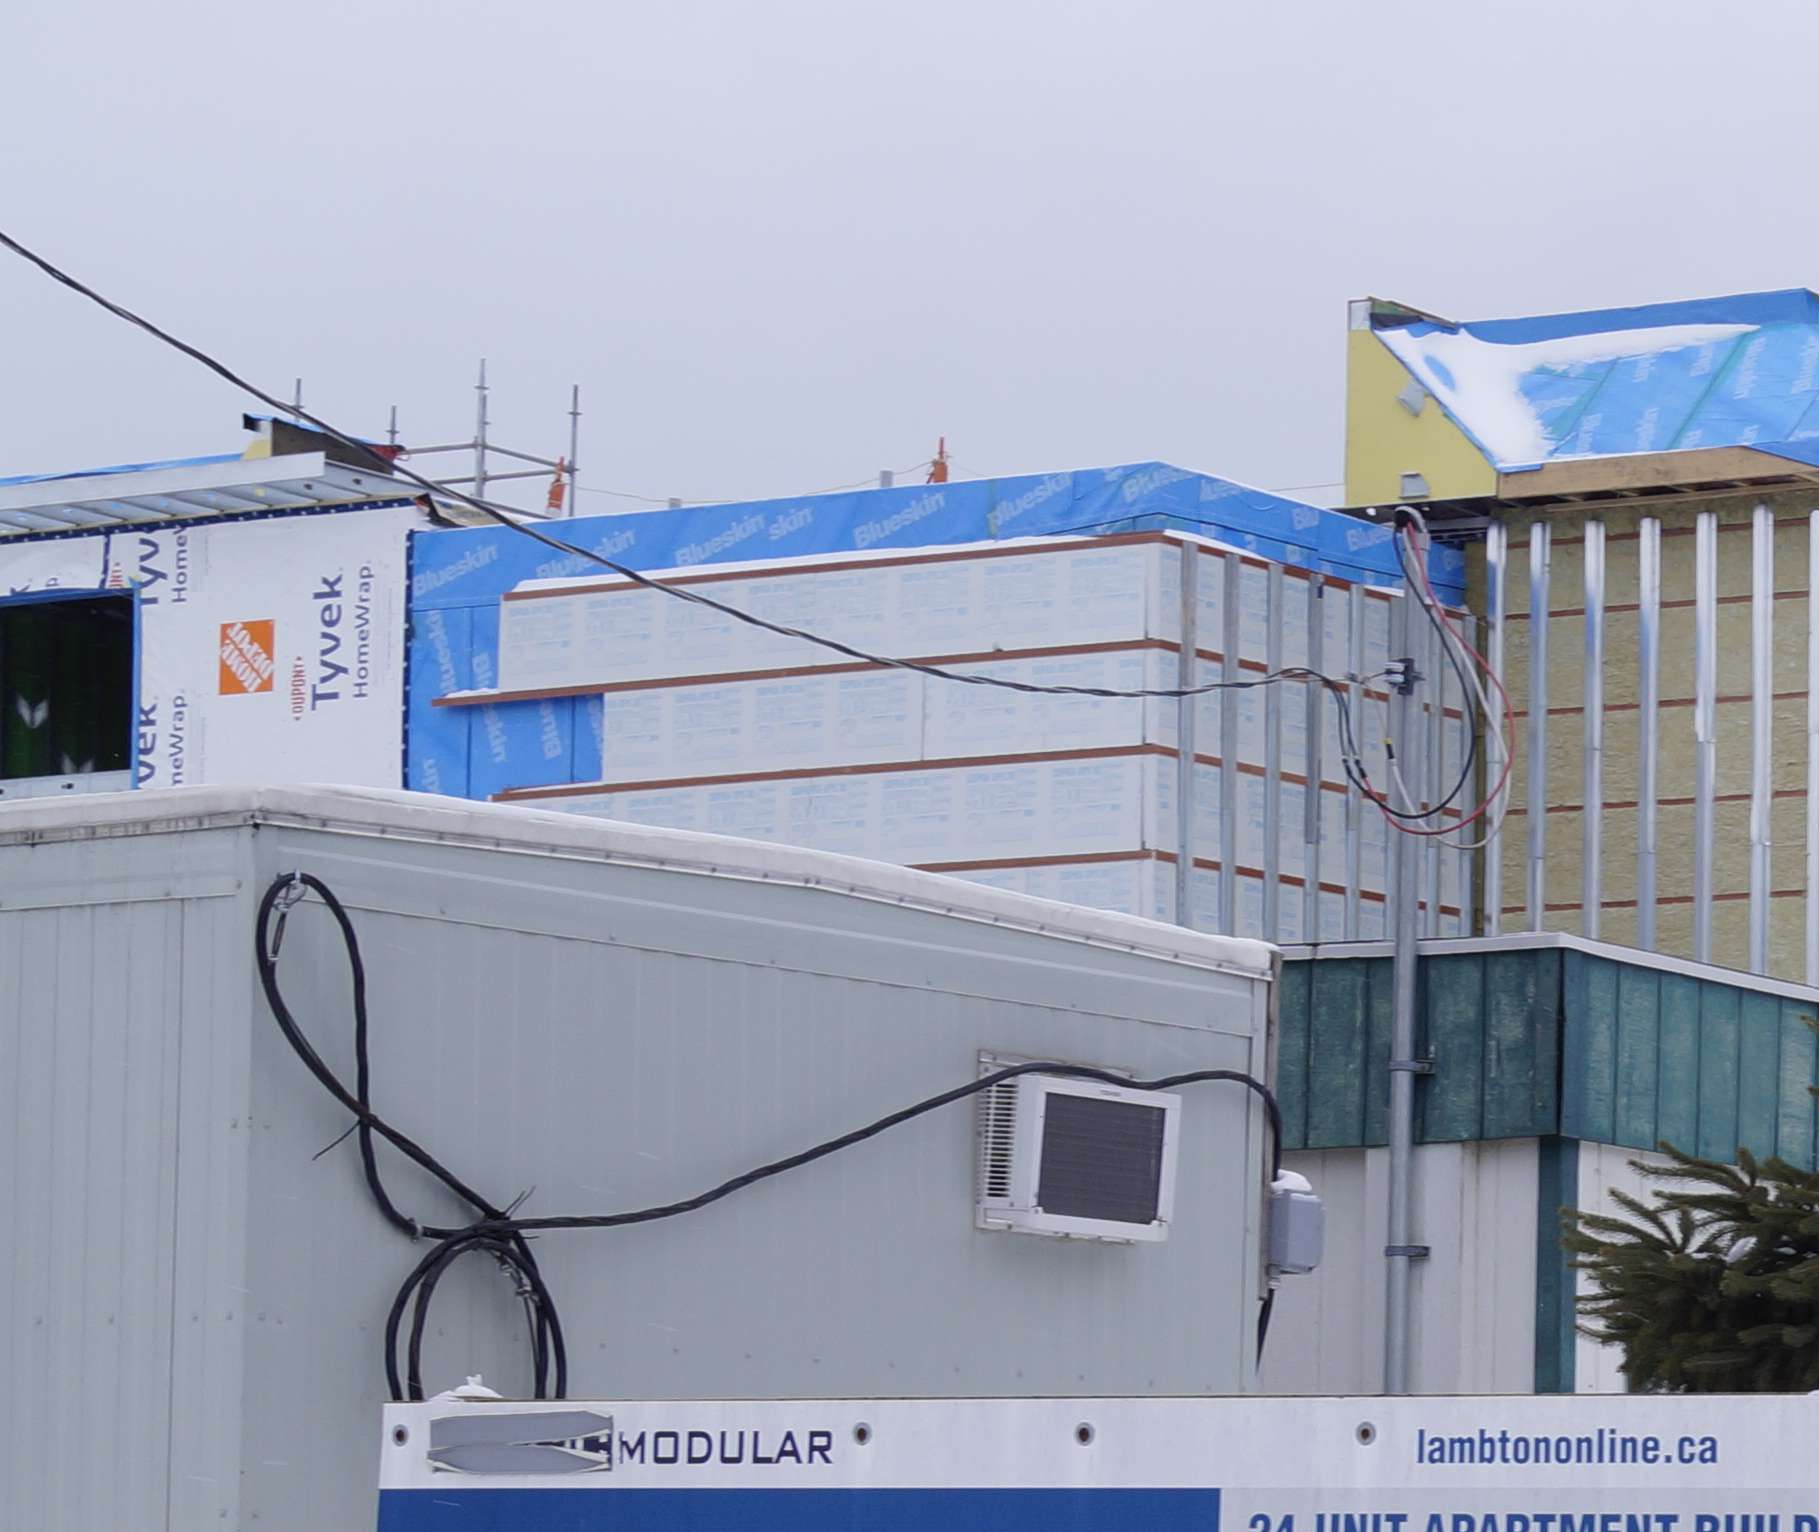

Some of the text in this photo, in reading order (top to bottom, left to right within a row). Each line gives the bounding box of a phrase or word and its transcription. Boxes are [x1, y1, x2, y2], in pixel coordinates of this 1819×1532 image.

[674, 513, 767, 566] Blueskin
[853, 491, 946, 549] Blueskin
[412, 544, 498, 598] Blueskin
[311, 574, 349, 711] Tyvek
[353, 565, 375, 699] HomeWrap
[618, 1430, 833, 1465] MODULAR
[1417, 1428, 1719, 1466] lambtononline.ca
